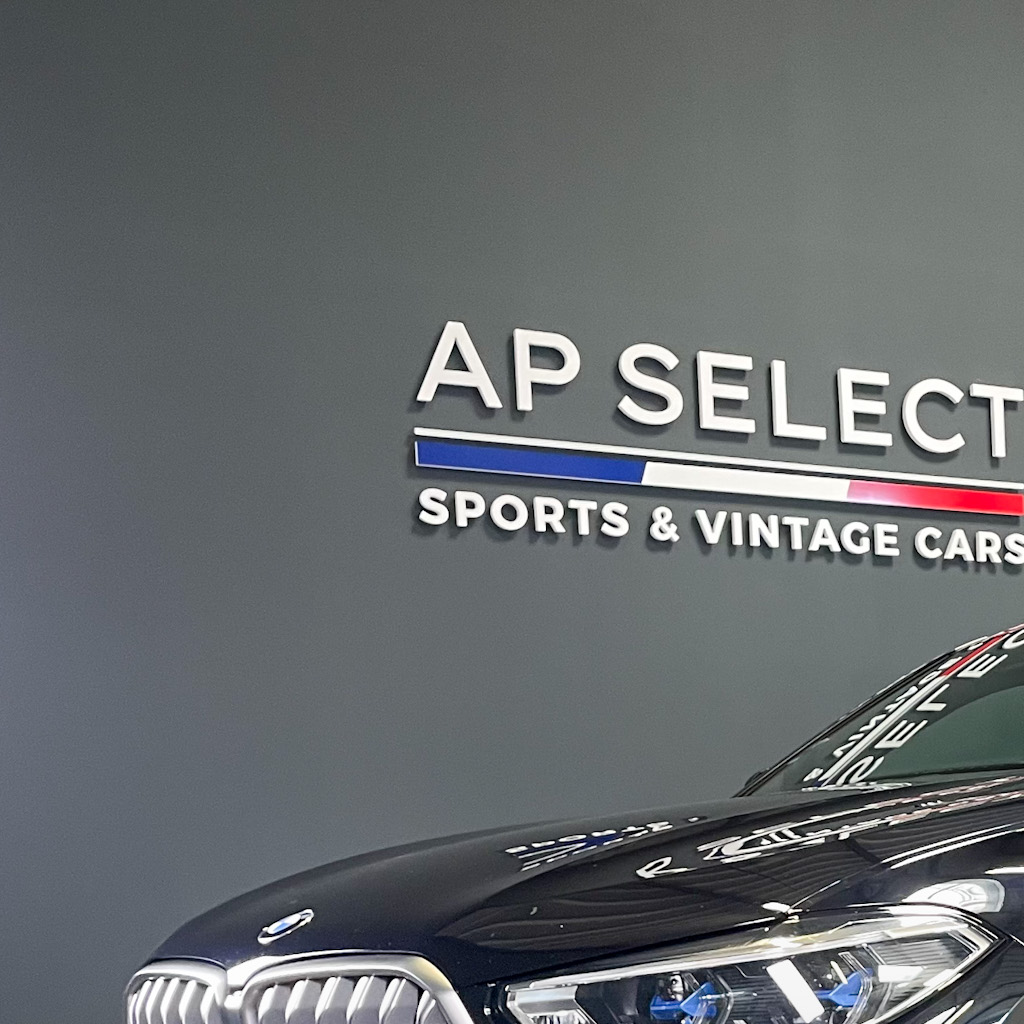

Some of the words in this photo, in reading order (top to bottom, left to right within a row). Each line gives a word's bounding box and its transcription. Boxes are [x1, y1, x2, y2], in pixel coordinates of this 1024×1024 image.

[416, 320, 581, 411] AP
[617, 342, 1024, 458] SELECT
[418, 487, 629, 537] SPORTS
[649, 505, 680, 543] &
[695, 509, 900, 557] VINTAGE
